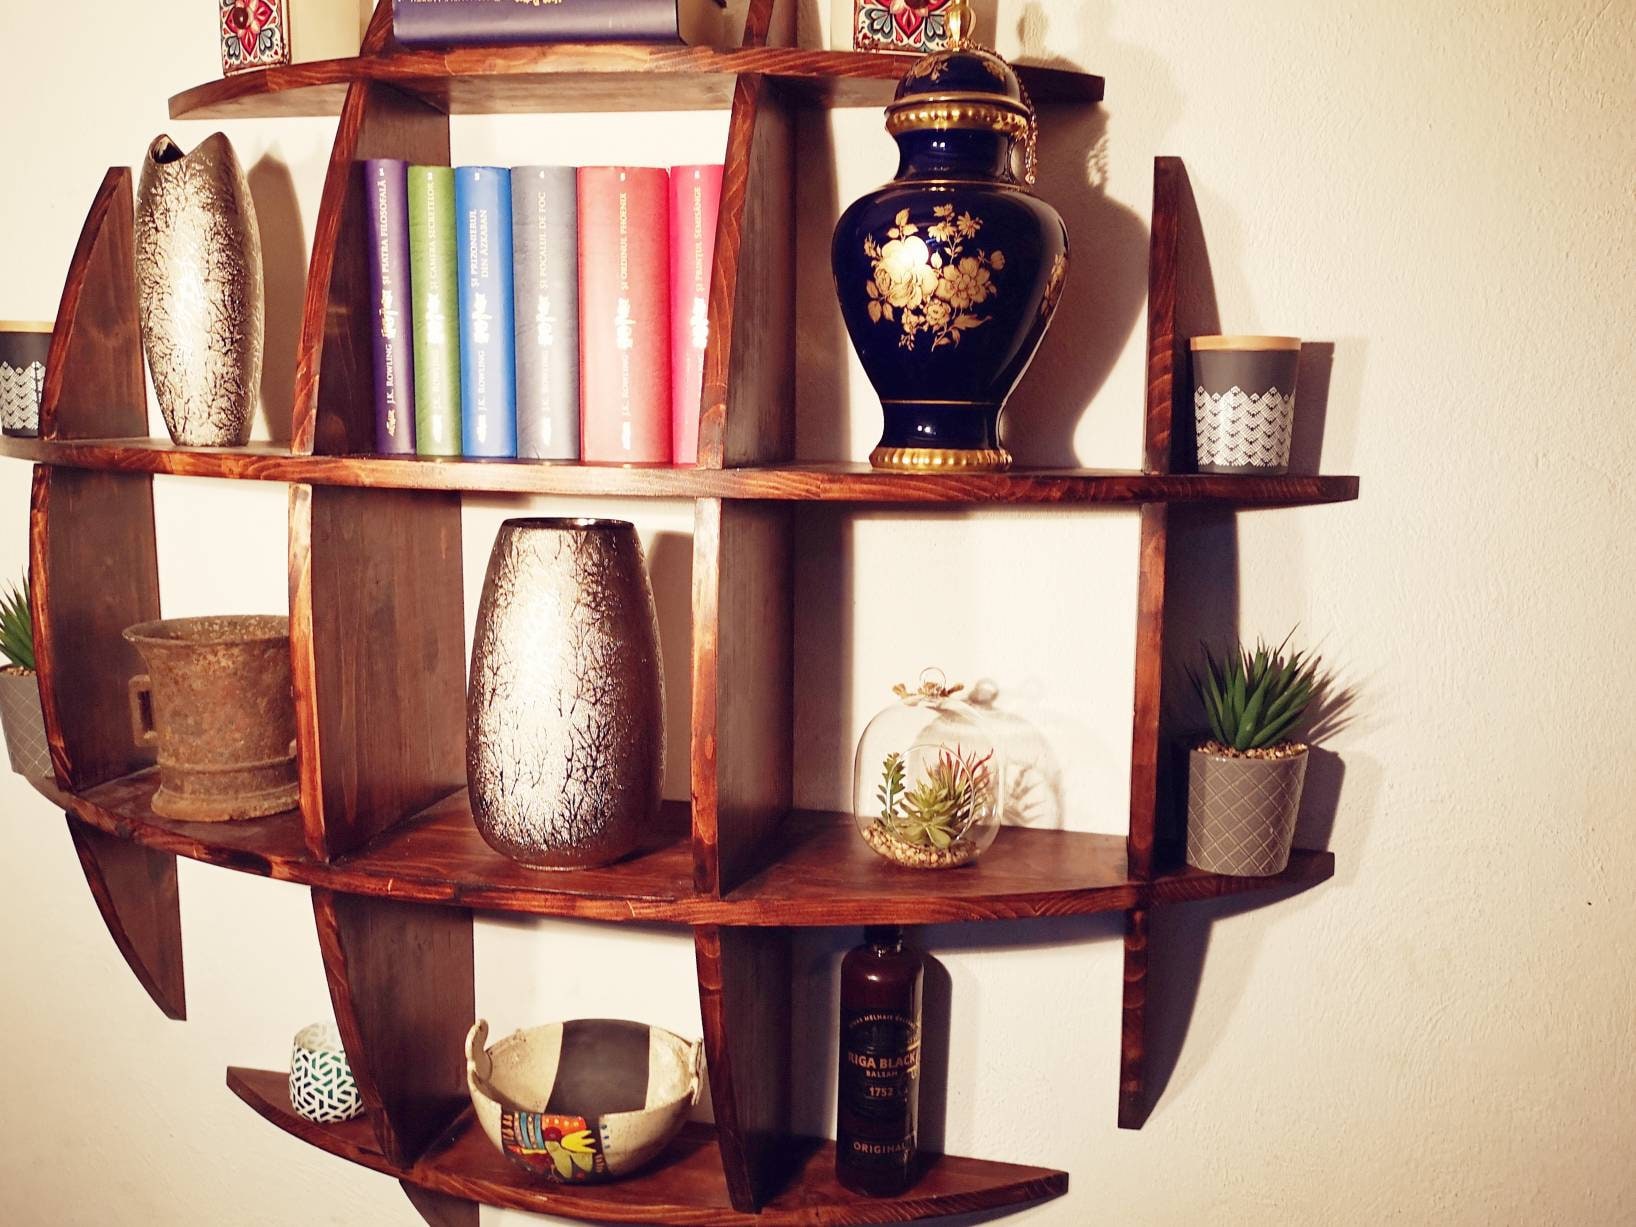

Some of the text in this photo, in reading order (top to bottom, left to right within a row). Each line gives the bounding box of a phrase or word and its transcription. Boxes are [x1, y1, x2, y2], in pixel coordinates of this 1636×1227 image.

[538, 191, 546, 213] FOC
[619, 191, 627, 235] PHOENIX
[539, 215, 547, 229] DE
[381, 238, 389, 273] PIATRA
[469, 209, 479, 275] PRIZONIERUL
[479, 209, 489, 278] DIN AZKABAN
[385, 344, 394, 387] ROWLING
[879, 1051, 916, 1070] BLACK
